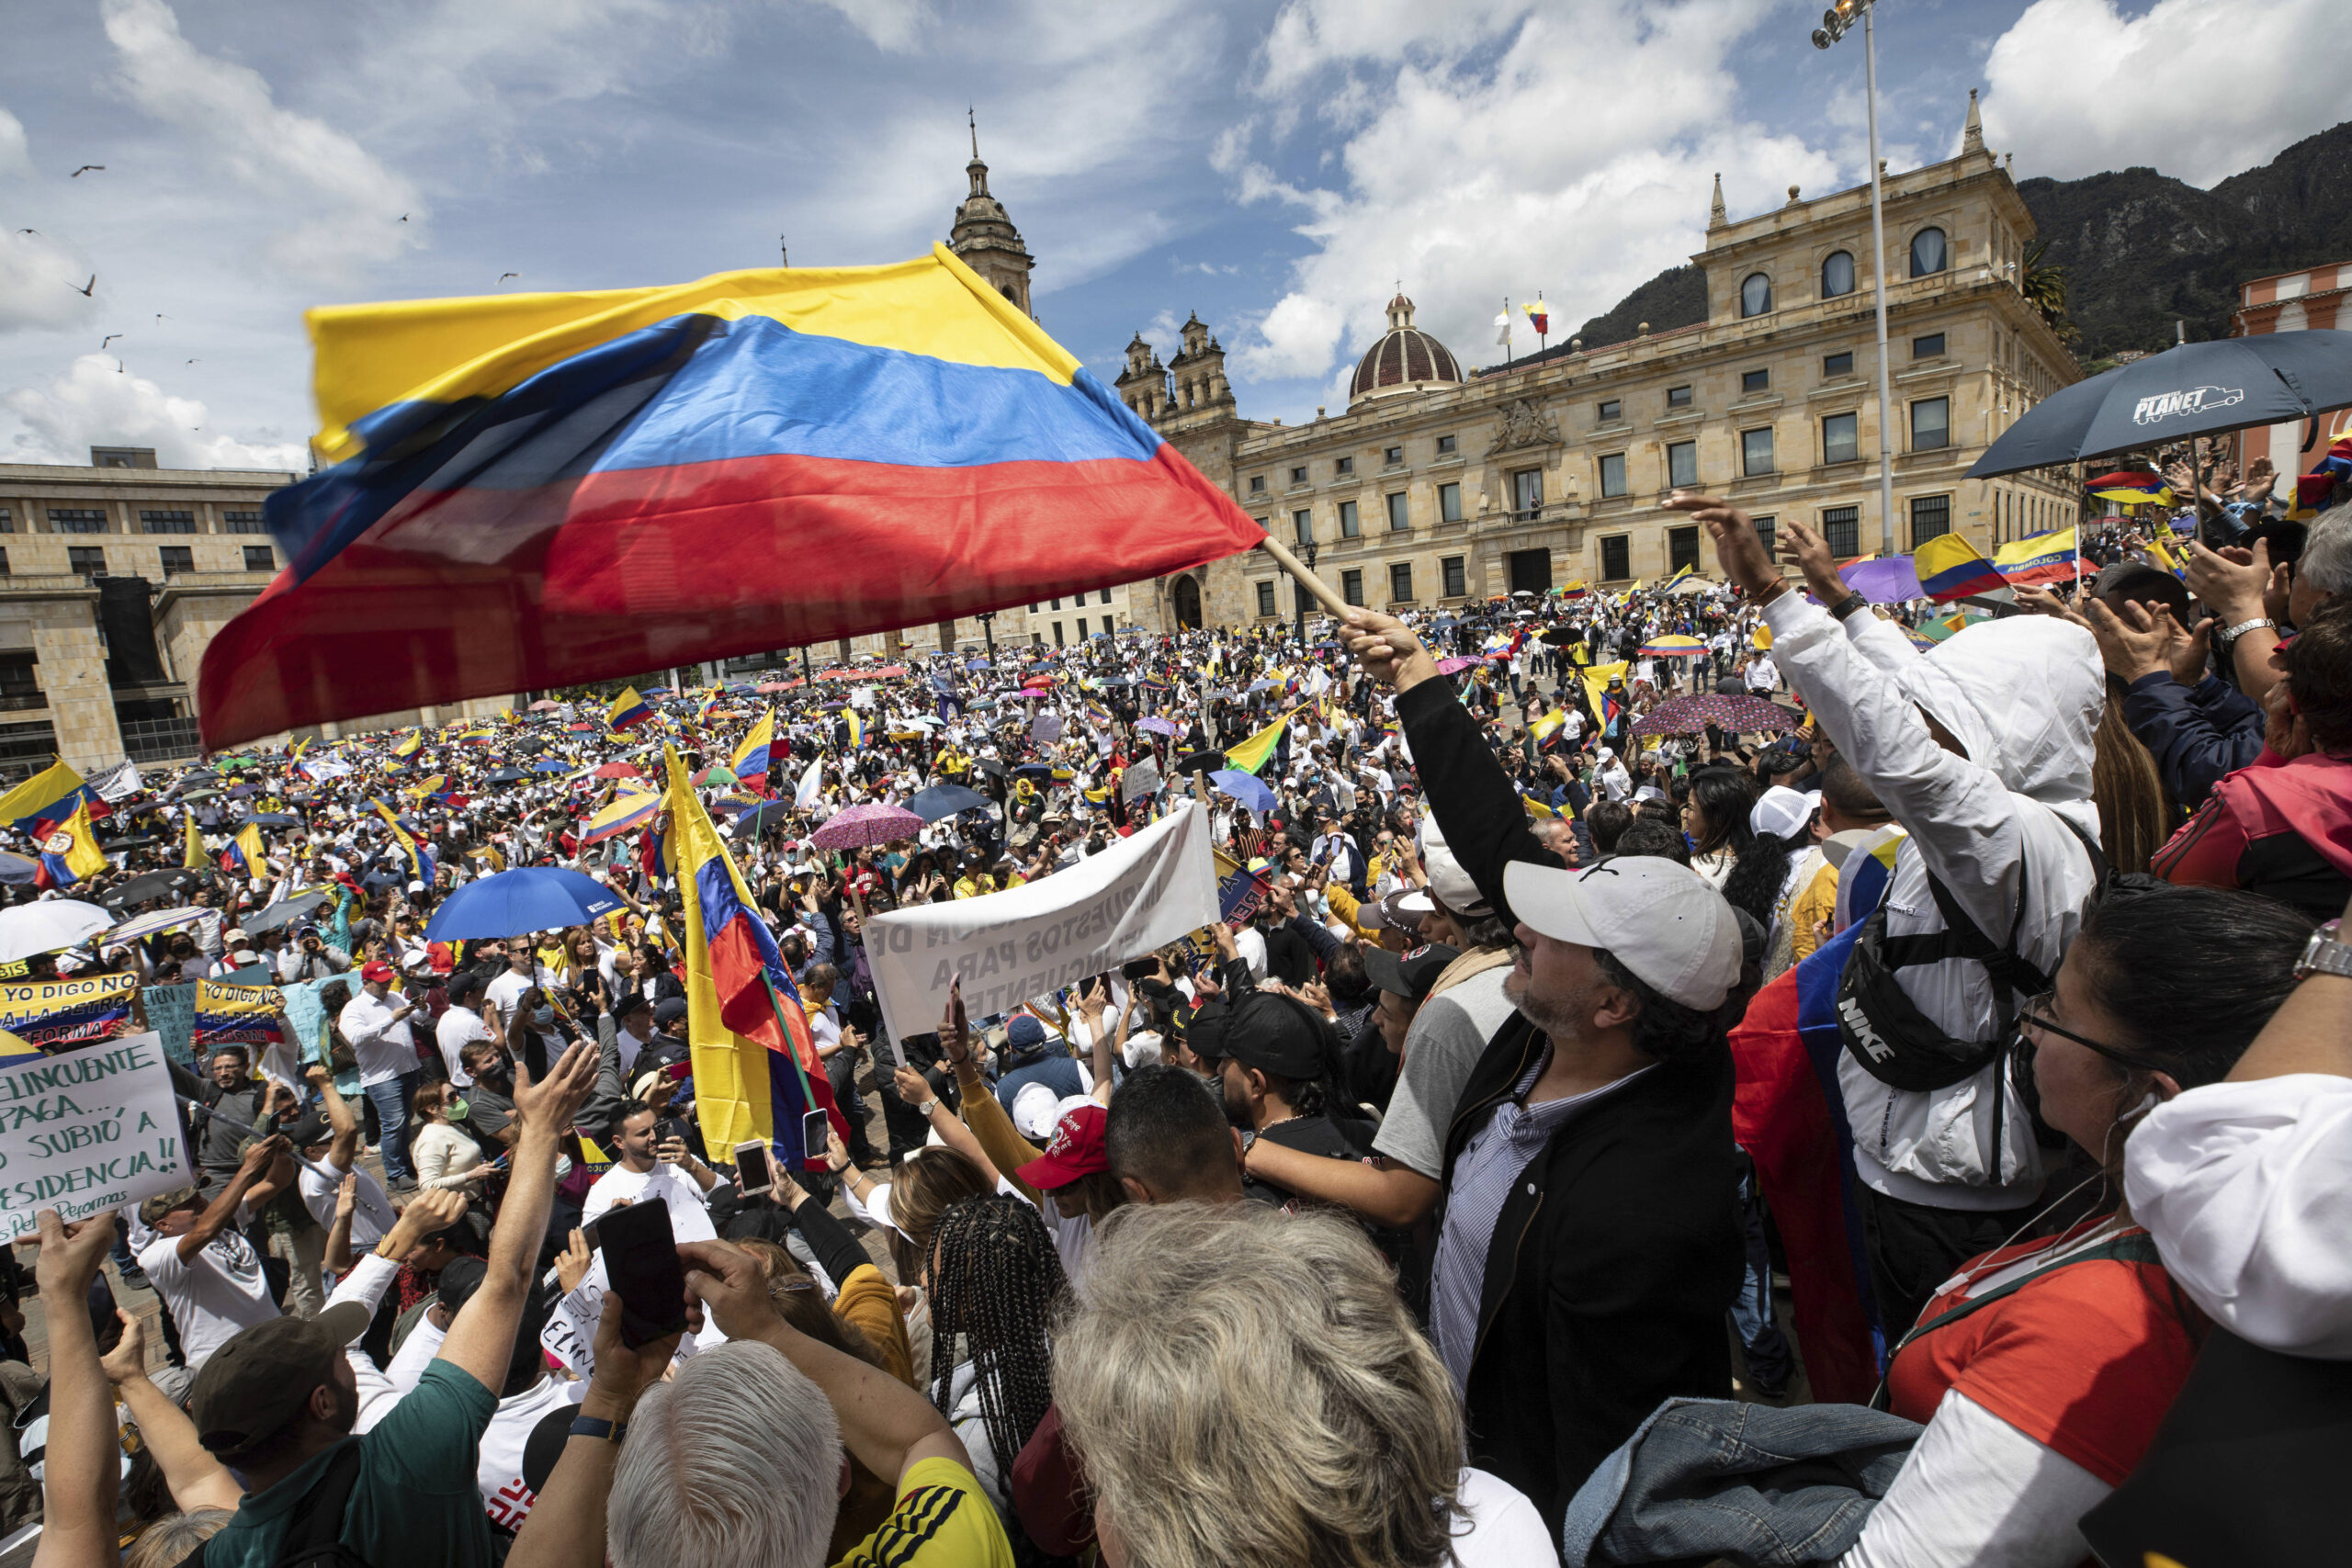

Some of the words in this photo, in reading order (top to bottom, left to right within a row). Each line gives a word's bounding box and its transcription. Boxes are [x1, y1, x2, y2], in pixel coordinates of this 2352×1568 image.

[2133, 389, 2208, 420] PLANET
[5, 987, 33, 1002] YO
[42, 981, 95, 999] DIGO
[101, 973, 137, 993] NO
[205, 984, 221, 1000] YO
[225, 987, 258, 1002] DIGO
[256, 988, 278, 1006] NO
[1, 1011, 17, 1028] A
[25, 1008, 51, 1023] LA
[59, 995, 127, 1018] PETRO
[201, 1008, 211, 1022] A
[213, 1009, 230, 1024] LA
[16, 1022, 103, 1045] FORMA
[1838, 997, 1895, 1064] NIKE
[28, 1107, 126, 1158] SUBIÓ
[138, 1111, 158, 1134] A
